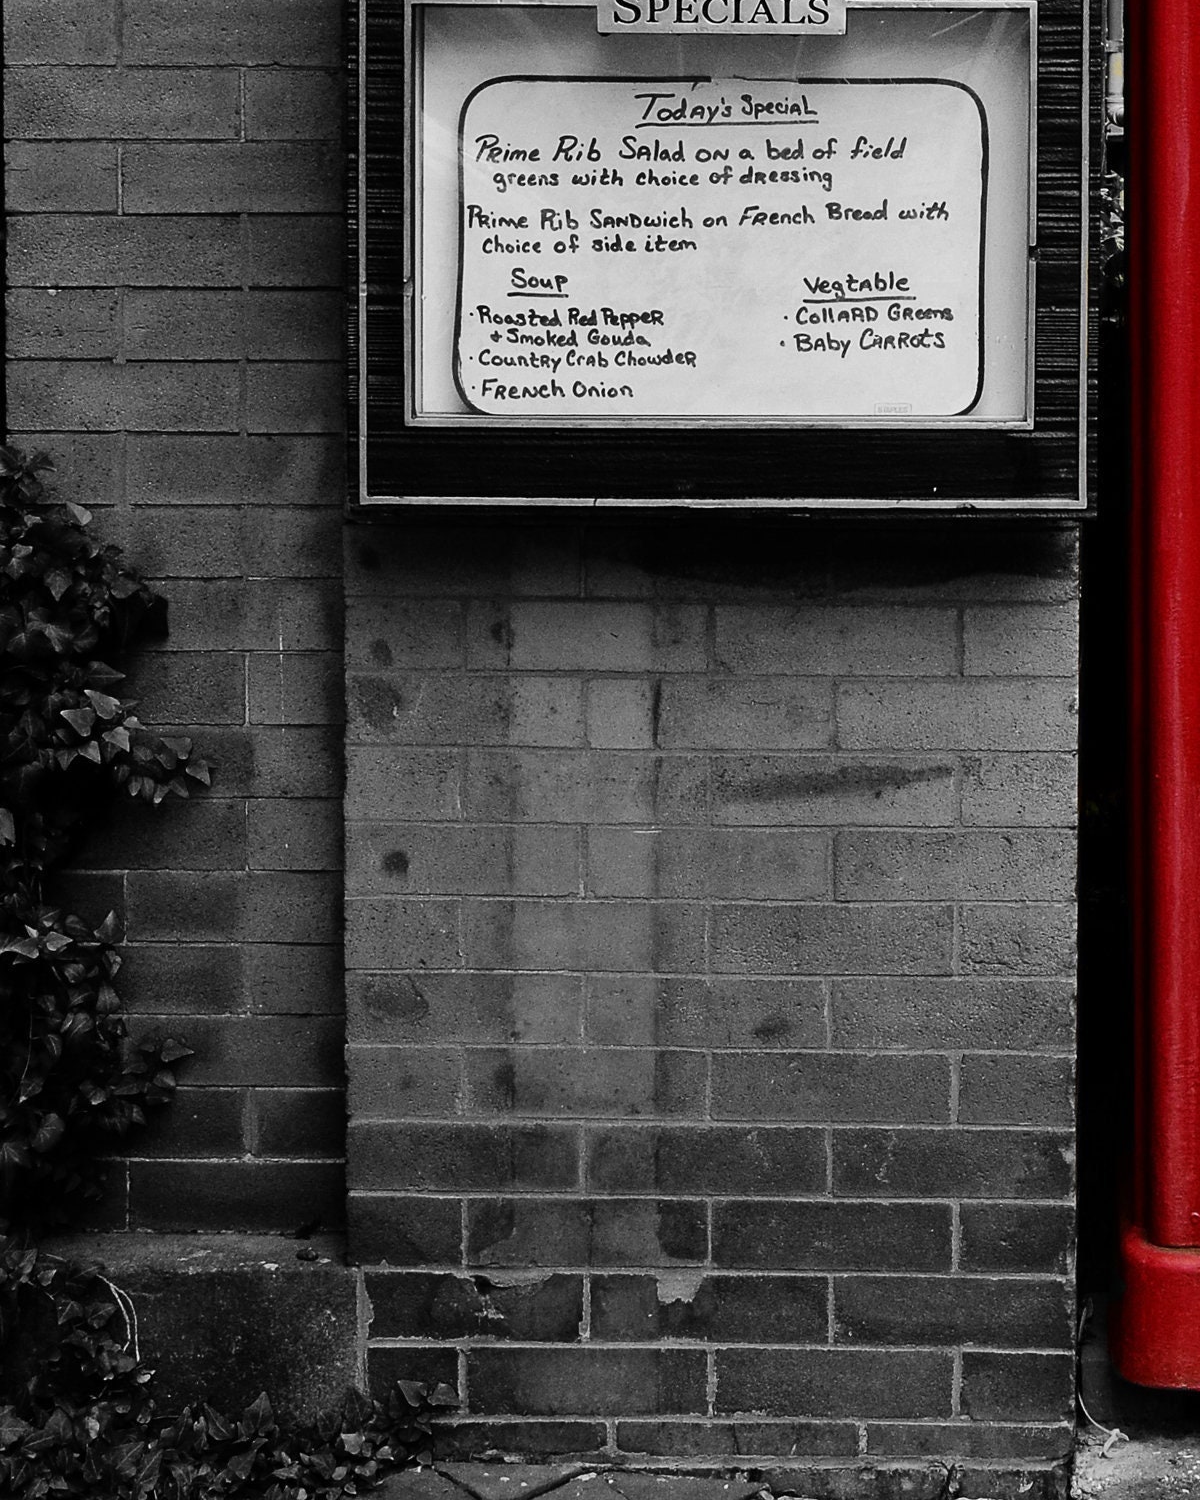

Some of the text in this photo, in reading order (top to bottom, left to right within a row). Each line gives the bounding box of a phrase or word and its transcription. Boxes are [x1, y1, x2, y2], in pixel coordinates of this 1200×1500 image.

[552, 135, 602, 162] Rib
[738, 148, 755, 161] a
[766, 138, 804, 160] bed
[812, 138, 838, 159] of
[850, 135, 907, 160] field
[492, 171, 560, 193] greens
[571, 167, 623, 187] with
[709, 165, 733, 184] of
[540, 208, 580, 231] Rib
[702, 213, 728, 228] on
[825, 198, 889, 221] Bread
[898, 201, 950, 222] with
[553, 233, 580, 253] of
[592, 234, 637, 252] side
[644, 235, 698, 252] item
[510, 267, 569, 292] Soup
[476, 304, 562, 327] Roasted
[568, 307, 598, 326] Red
[587, 330, 652, 347] Gouda
[572, 381, 634, 398] Onion
